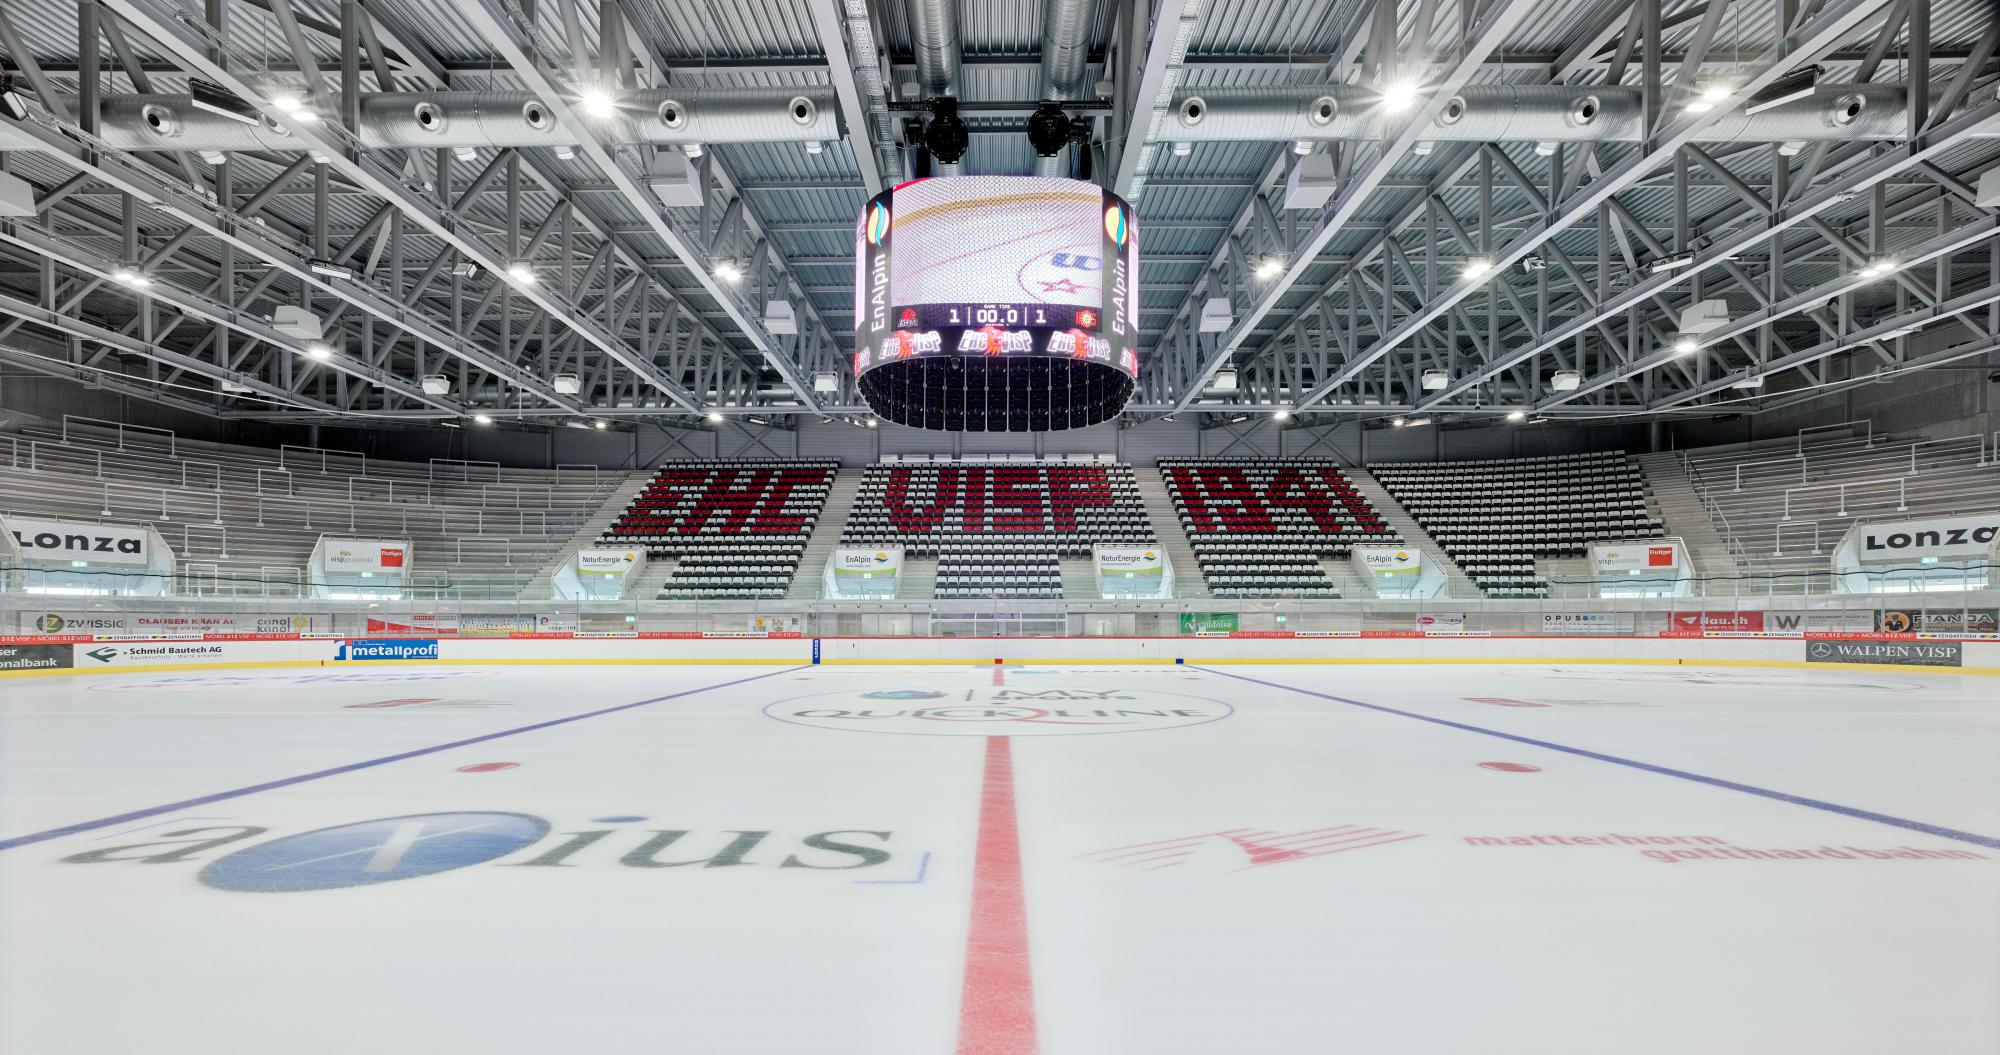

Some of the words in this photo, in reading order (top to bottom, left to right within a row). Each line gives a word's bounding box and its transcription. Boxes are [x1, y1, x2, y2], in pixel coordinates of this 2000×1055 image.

[871, 253, 889, 332] EnAlpin
[1112, 259, 1127, 335] EnAlpin
[949, 309, 960, 323] 1
[977, 309, 1018, 323] 00.0
[1035, 309, 1047, 323] 1
[911, 330, 942, 354] VISP
[957, 329, 988, 351] EHC
[1000, 329, 1033, 352] VISP
[1046, 330, 1076, 352] EHC
[1087, 336, 1111, 360] VISP
[12, 531, 141, 553] Lonza
[1867, 527, 1999, 550] Lonza
[1366, 555, 1392, 563] EnAlpin
[352, 644, 438, 658] metallprofi
[1838, 645, 1909, 656] WALPEN
[1914, 646, 1957, 658] VISP
[1463, 833, 1730, 846] matterhorn
